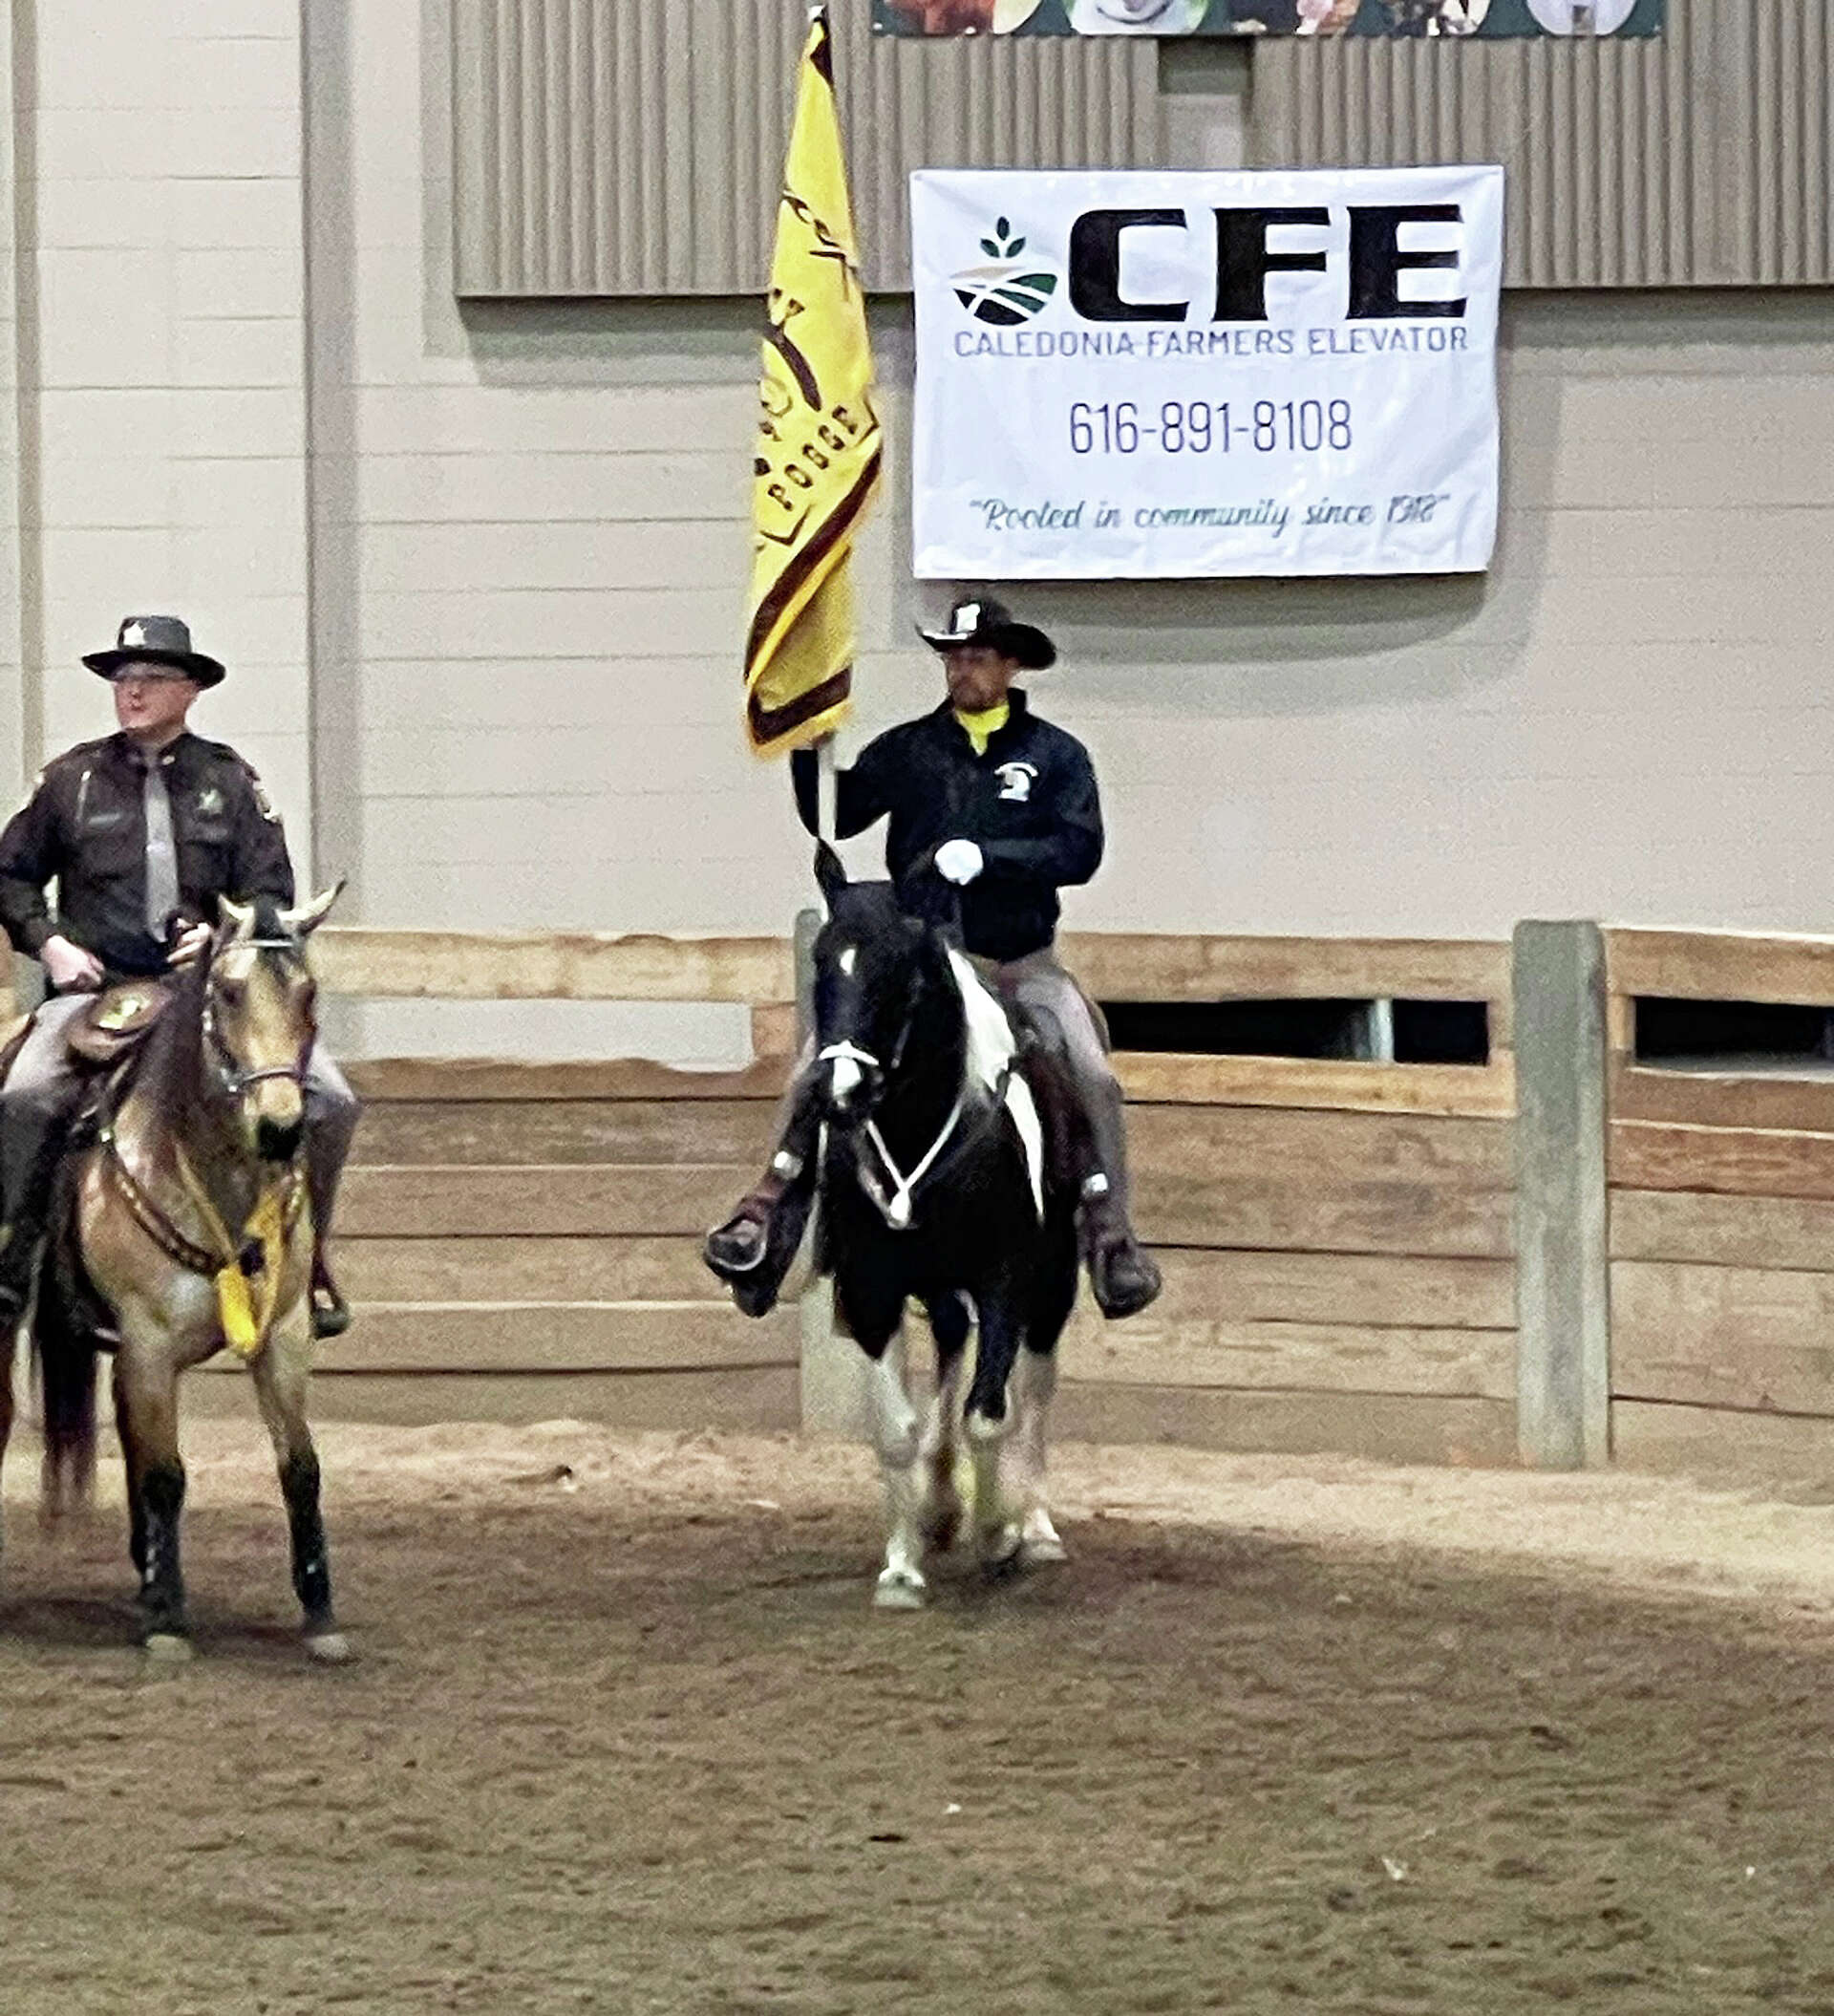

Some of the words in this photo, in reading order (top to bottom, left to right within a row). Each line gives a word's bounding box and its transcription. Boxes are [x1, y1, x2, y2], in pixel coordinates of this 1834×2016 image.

[1069, 204, 1468, 323] CFE
[954, 331, 1135, 357] CALEDONIA
[1146, 329, 1294, 356] FARMERS
[1308, 326, 1469, 354] ELEVATOR
[1069, 399, 1353, 454] 616-891-8108
[1096, 500, 1121, 528] in
[1134, 498, 1290, 539] community
[1302, 496, 1374, 525] since
